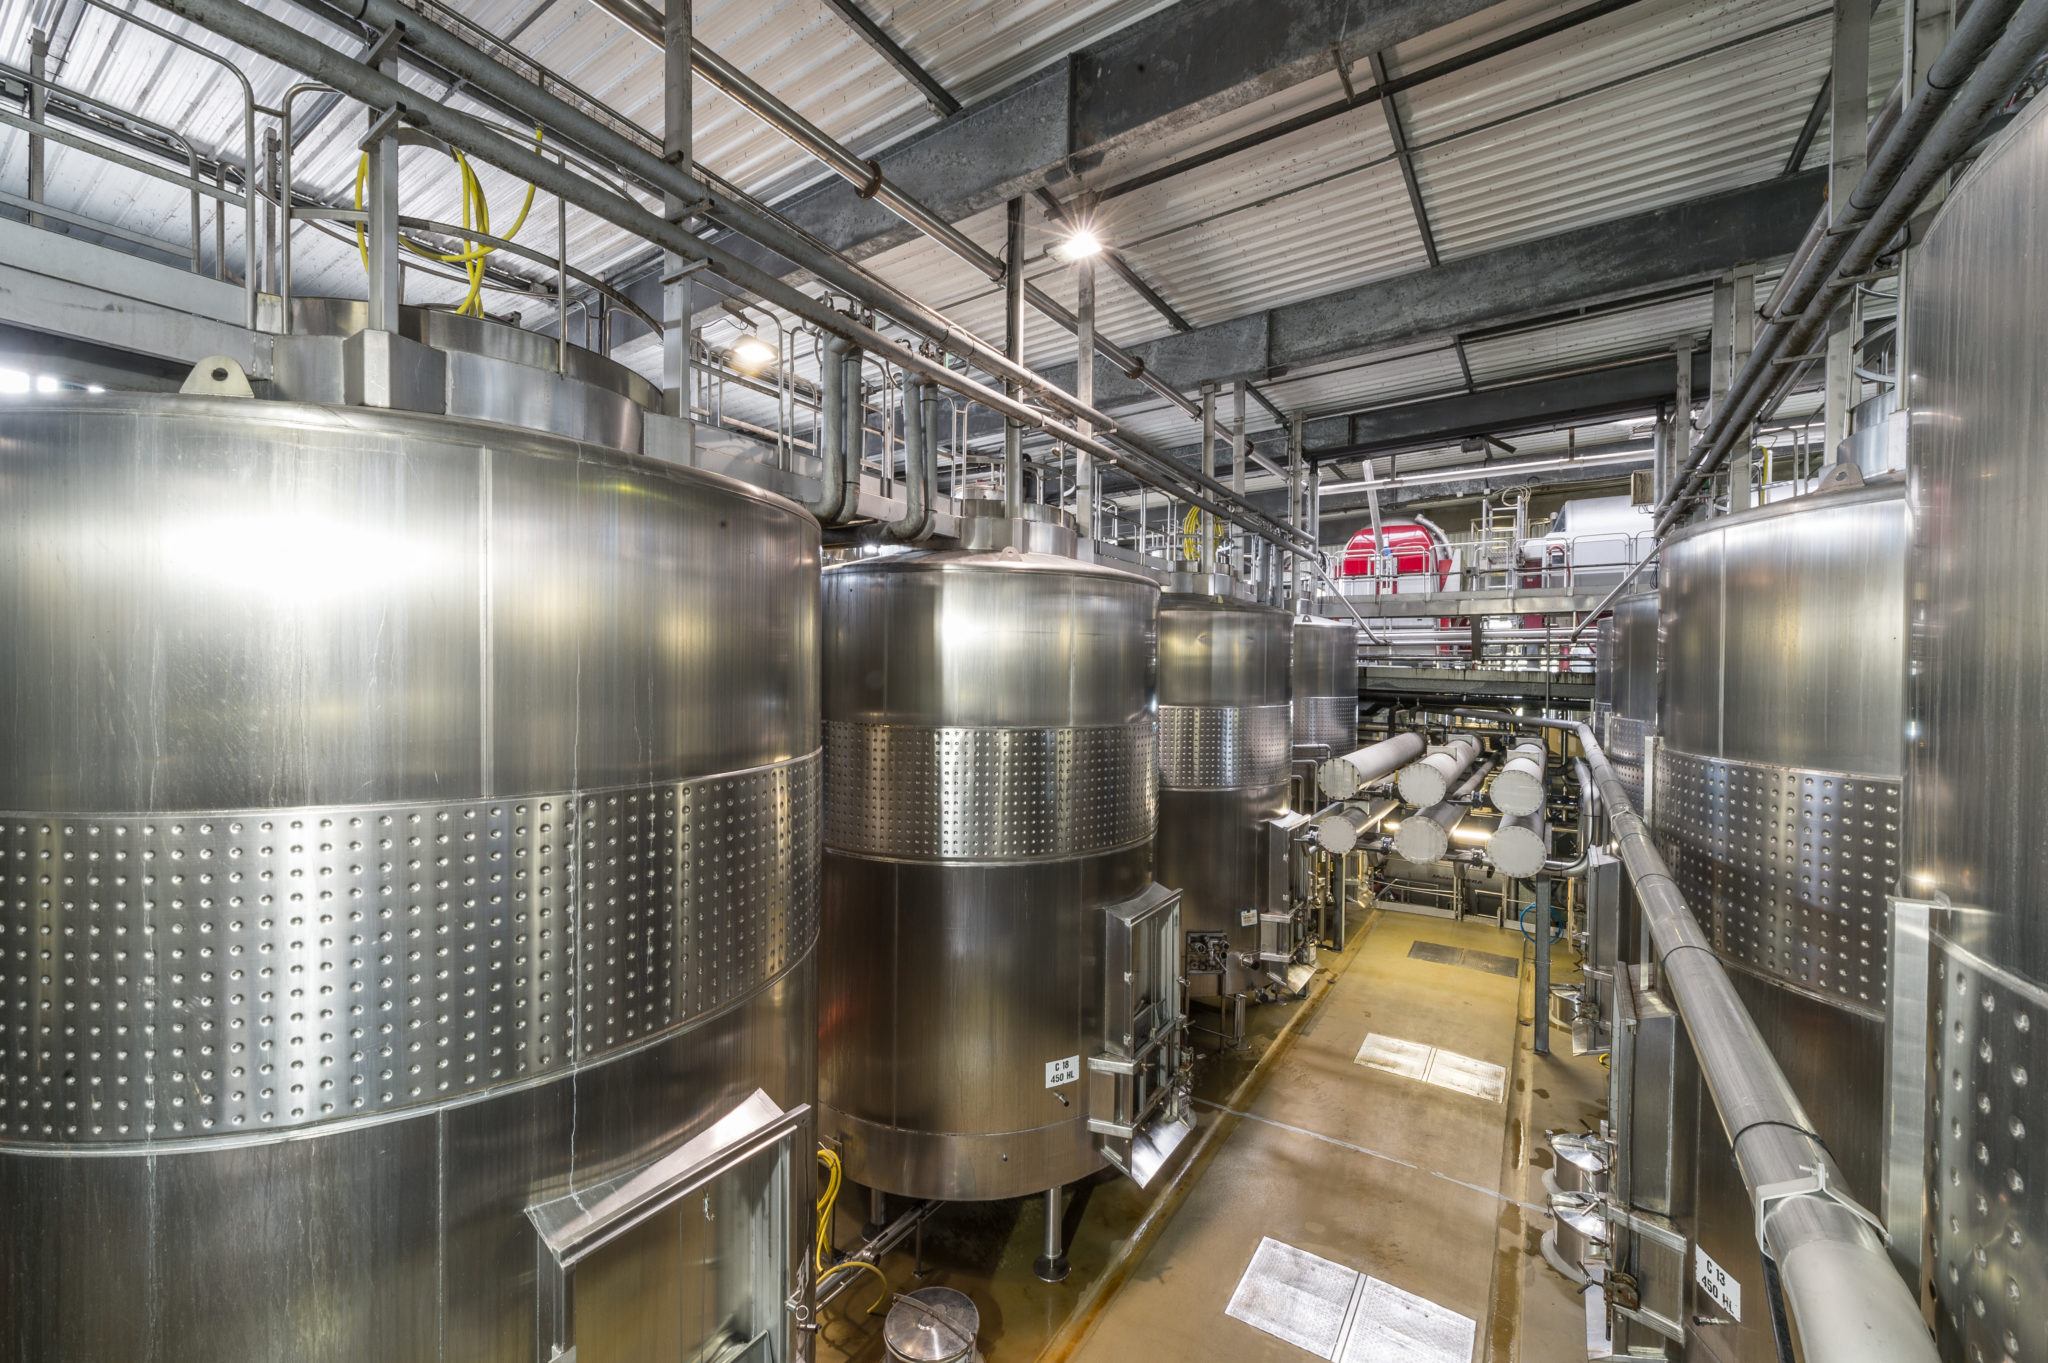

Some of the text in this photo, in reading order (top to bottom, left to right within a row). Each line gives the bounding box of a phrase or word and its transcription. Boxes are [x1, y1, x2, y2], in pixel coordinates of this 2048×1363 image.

[1055, 1060, 1070, 1071] C 18
[1050, 1070, 1075, 1083] 450 HL
[1706, 1260, 1726, 1286] C 13
[1701, 1275, 1735, 1314] 450 HL
